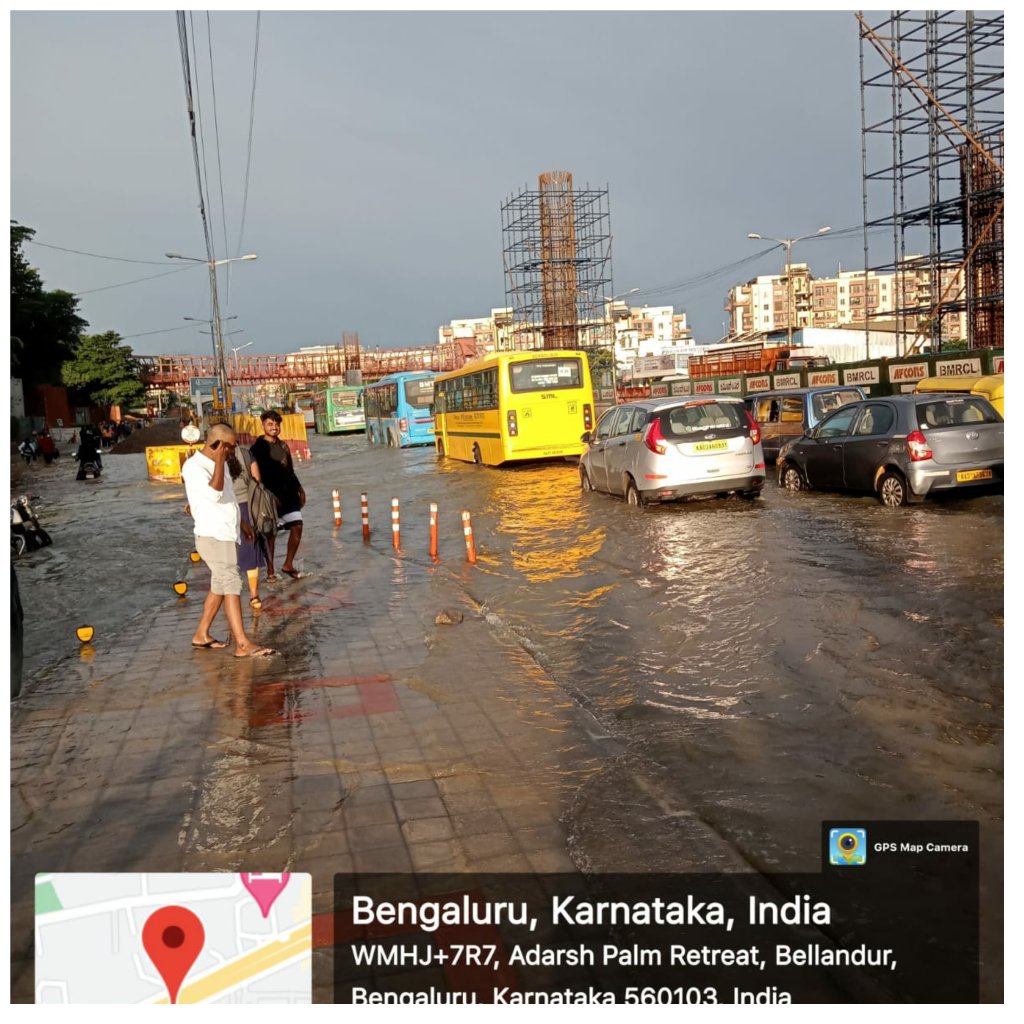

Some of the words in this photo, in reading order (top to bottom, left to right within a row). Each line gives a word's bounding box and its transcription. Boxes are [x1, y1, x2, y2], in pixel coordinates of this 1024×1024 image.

[893, 366, 925, 379] AFCONS
[939, 362, 978, 376] BMRCL
[775, 377, 798, 387] BMRCL
[811, 373, 836, 385] AFCONS
[846, 370, 876, 383] BMRCL
[748, 379, 769, 389] AFCONS
